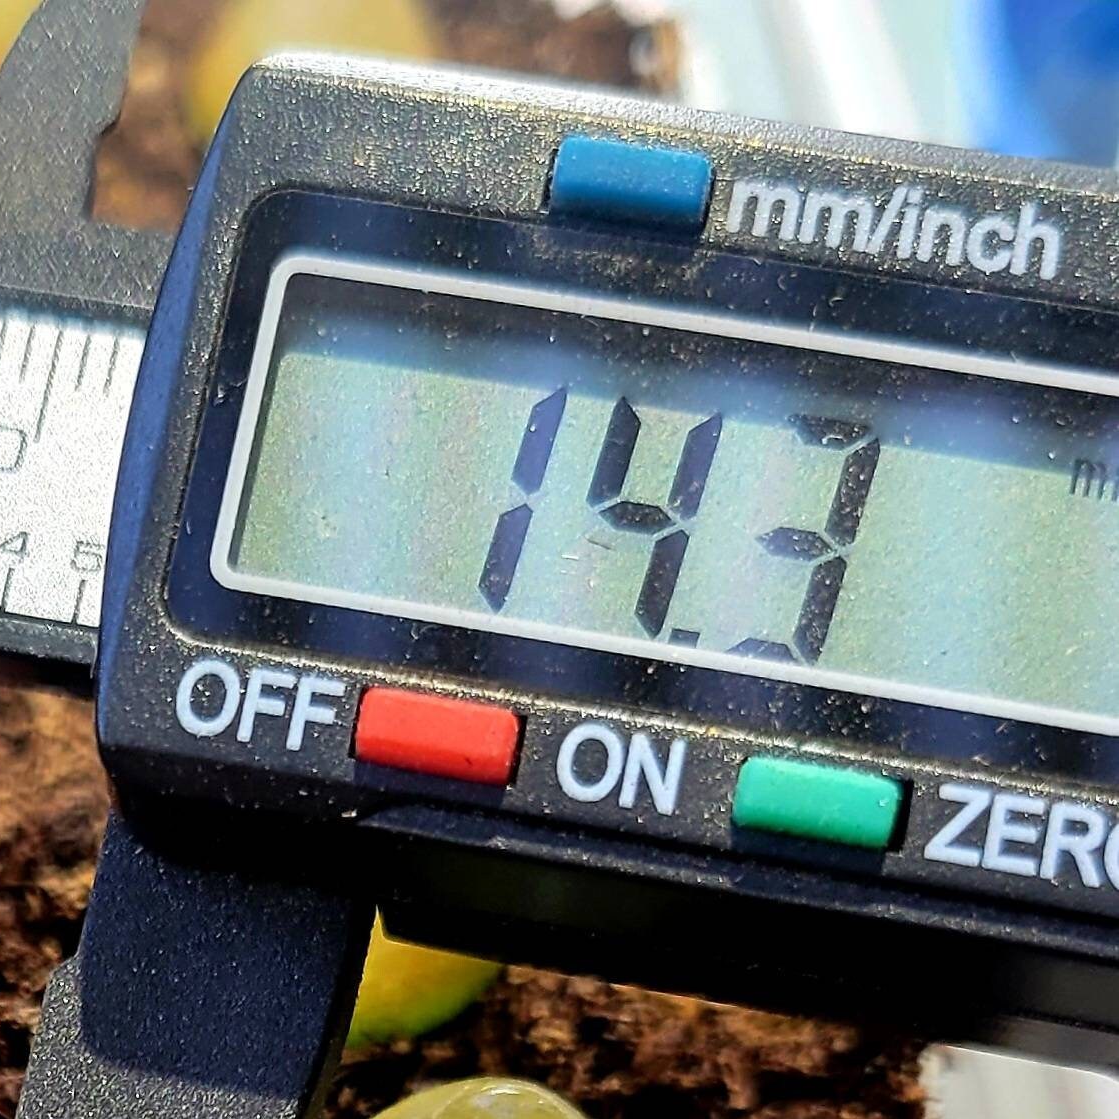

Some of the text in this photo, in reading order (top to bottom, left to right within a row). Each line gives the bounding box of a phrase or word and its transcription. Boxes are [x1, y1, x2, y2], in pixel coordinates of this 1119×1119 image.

[728, 179, 1062, 281] mm/inch
[478, 386, 881, 664] 14.3
[1068, 457, 1119, 502] m
[70, 539, 104, 574] 5
[174, 658, 347, 752] OFF
[555, 720, 688, 816] ON
[923, 782, 1119, 892] ZER
